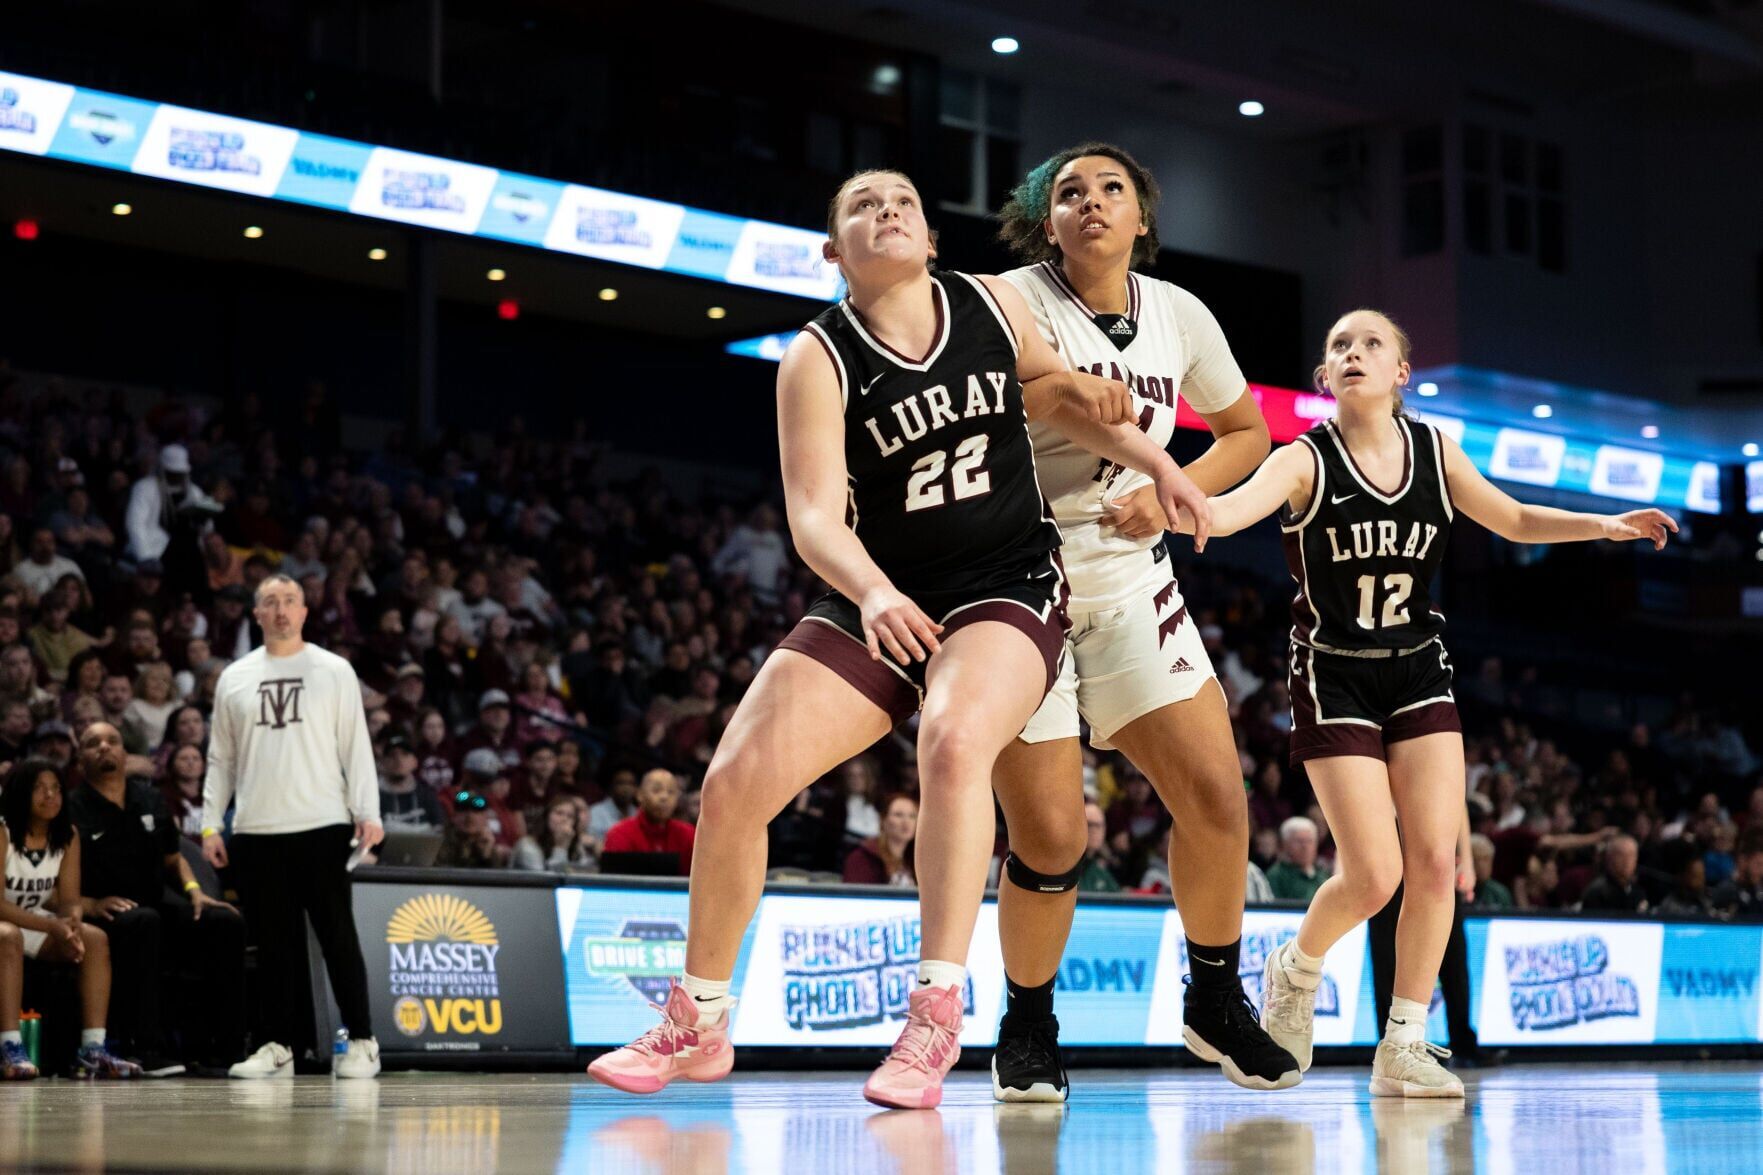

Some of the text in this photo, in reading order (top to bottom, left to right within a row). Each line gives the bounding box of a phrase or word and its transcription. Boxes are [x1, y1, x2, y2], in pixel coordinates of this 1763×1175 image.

[1109, 325, 1133, 335] adidas
[865, 372, 1007, 458] LURAY
[905, 433, 992, 513] 22
[1326, 520, 1438, 563] LURAY
[1356, 573, 1414, 630] 12
[1169, 665, 1195, 674] adidas
[389, 943, 499, 972] MASSEY
[592, 944, 649, 968] DRIVE
[389, 972, 498, 985] COMPREHENSIVE
[390, 984, 499, 996] CANCER CENTER
[424, 998, 503, 1035] VCU
